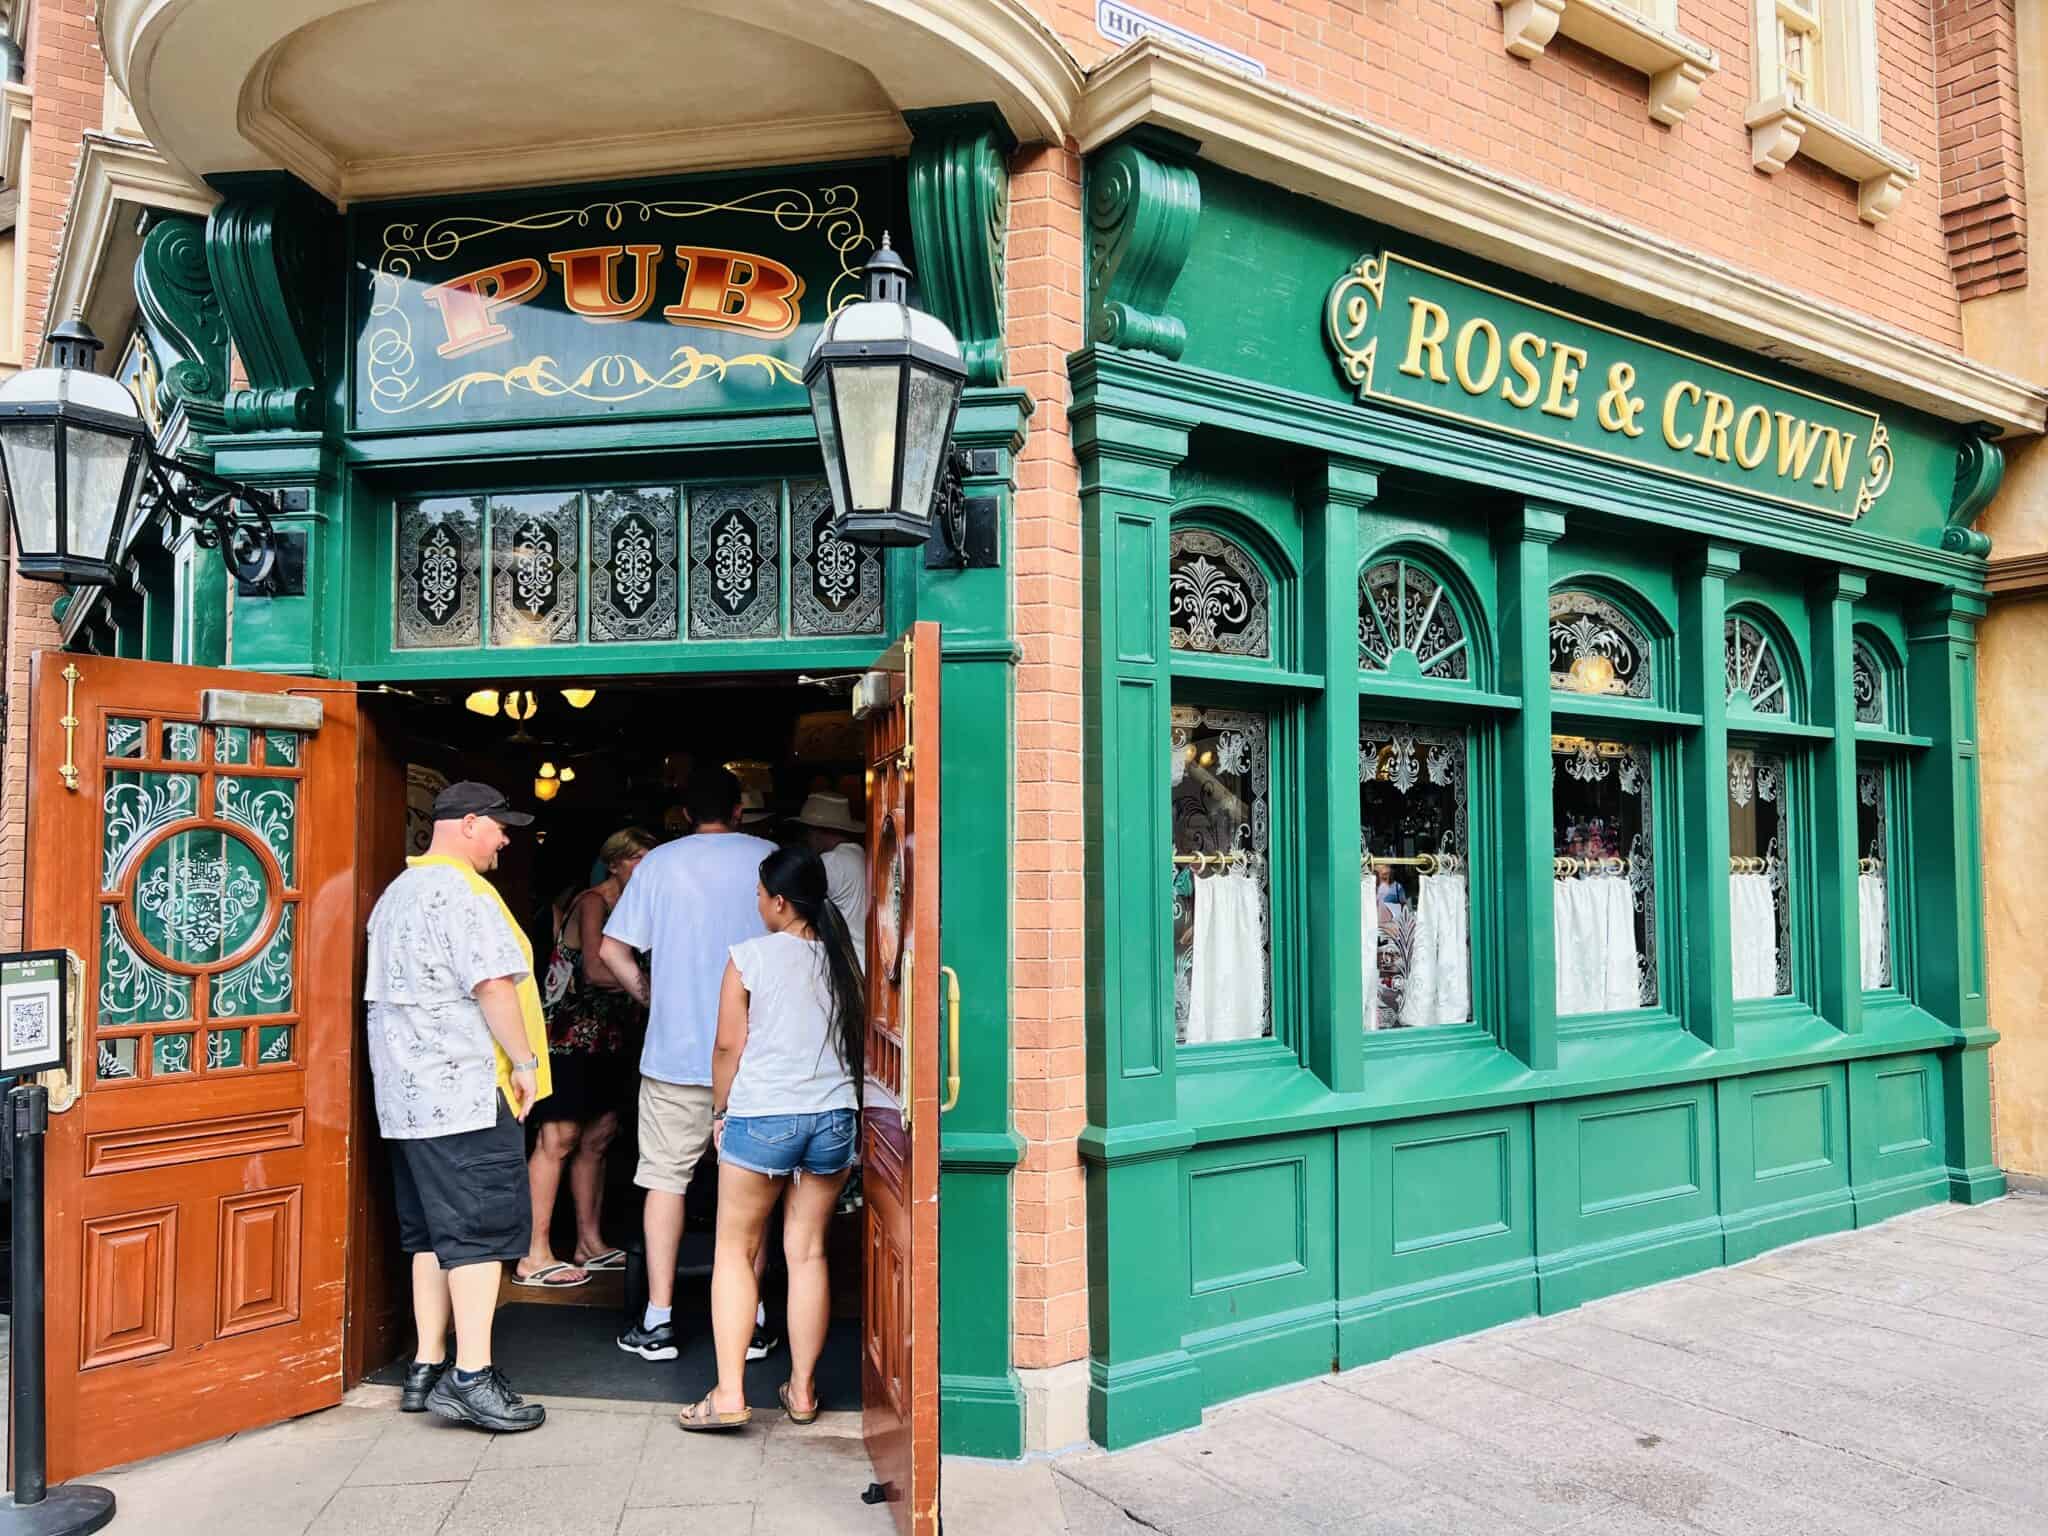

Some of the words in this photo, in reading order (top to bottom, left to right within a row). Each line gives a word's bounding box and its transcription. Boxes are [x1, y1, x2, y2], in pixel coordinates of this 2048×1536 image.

[423, 244, 806, 359] PUB
[1399, 296, 1588, 420] ROSE
[1598, 362, 1645, 437] &
[1662, 380, 1857, 491] CROWN
